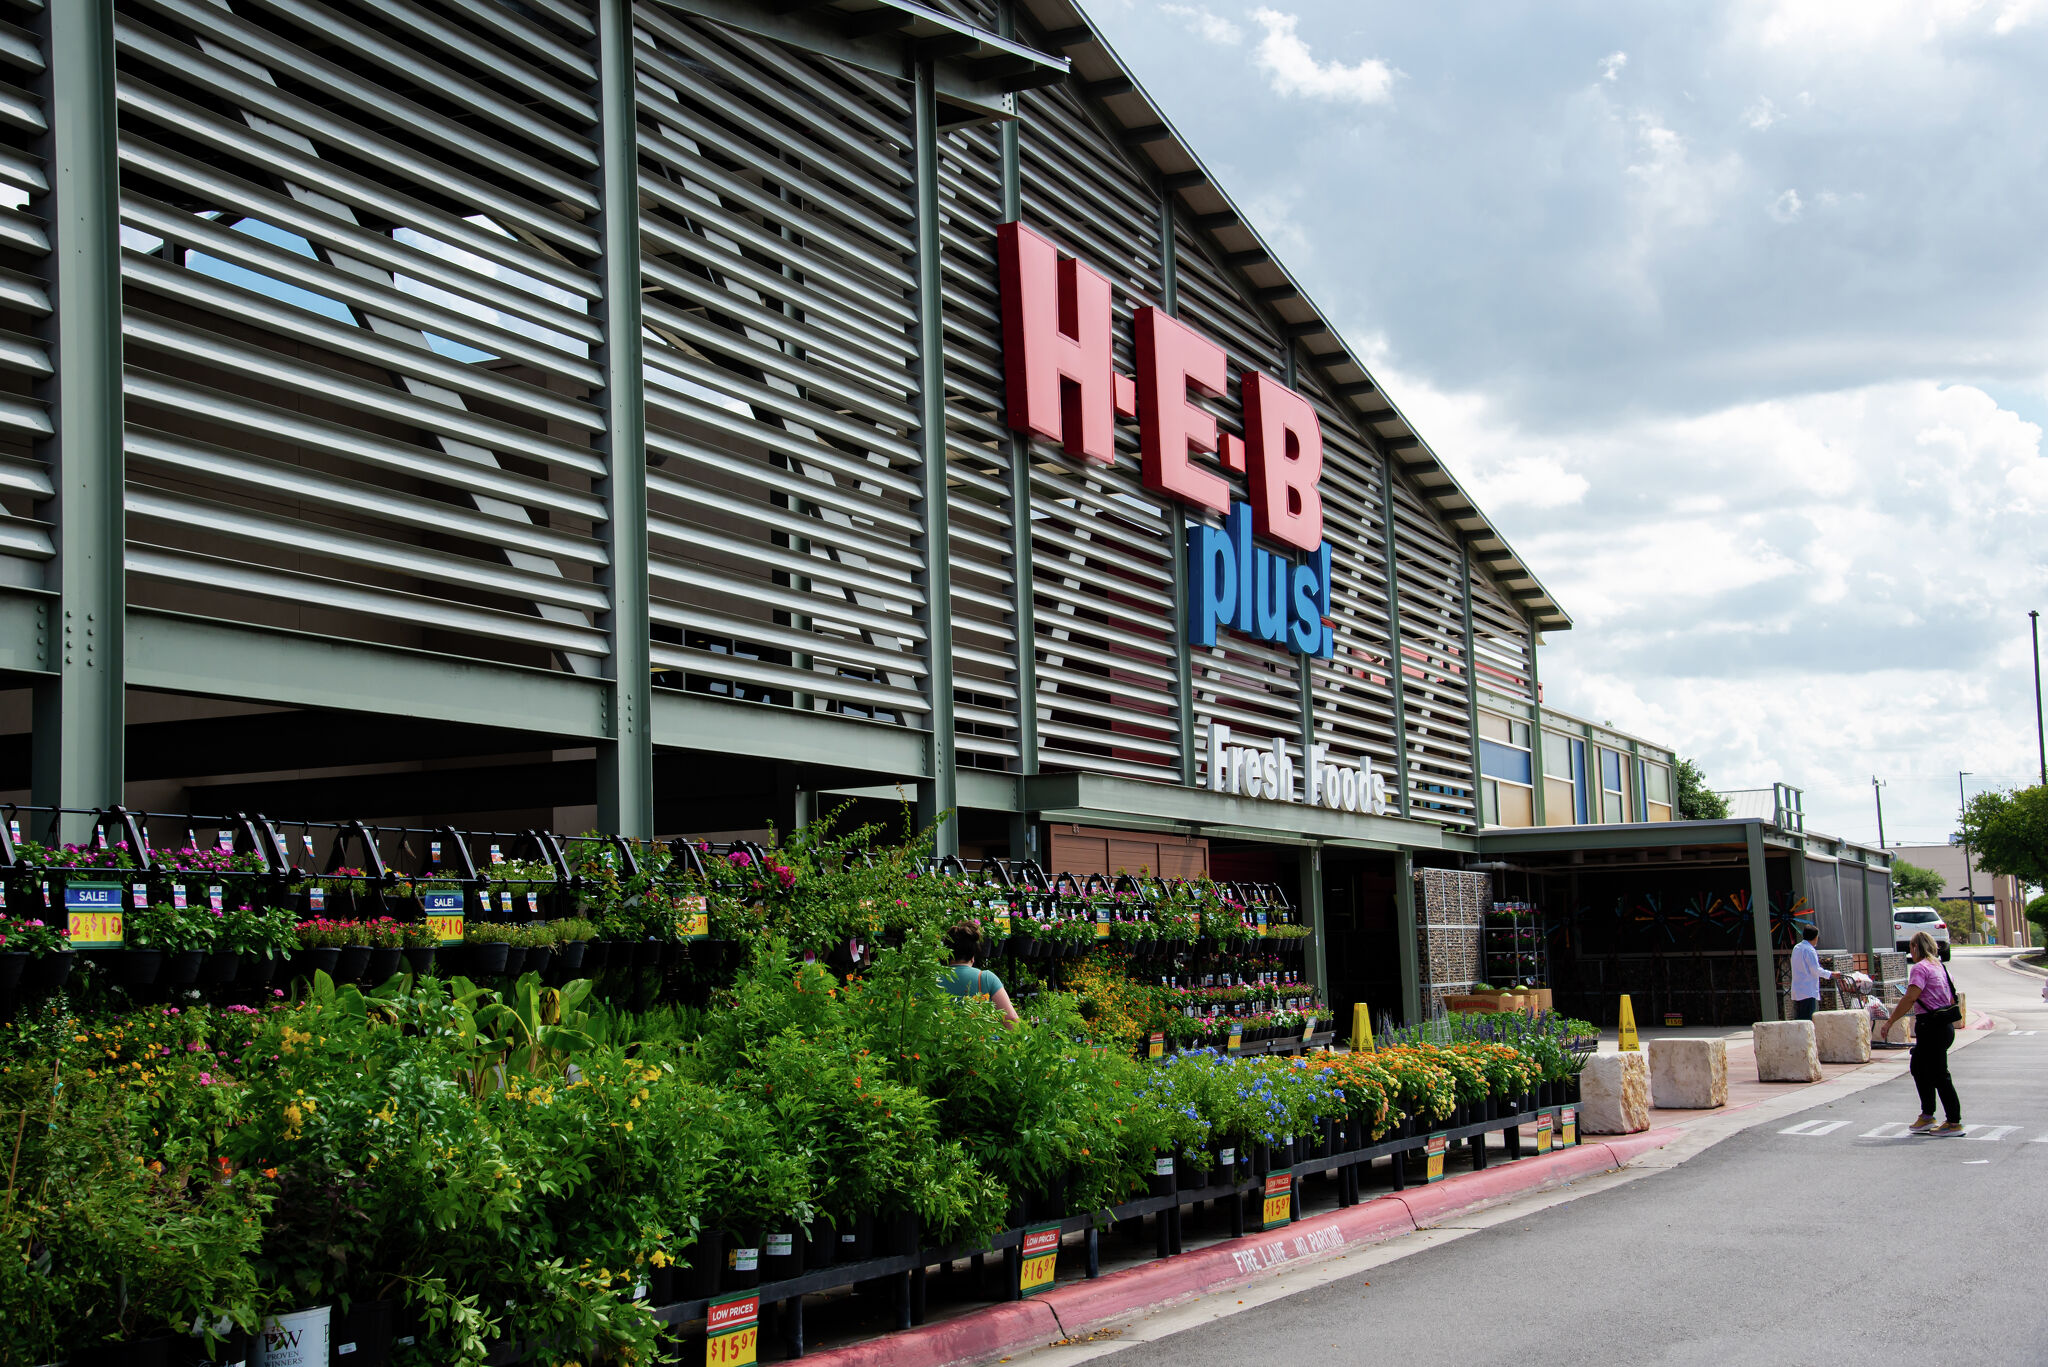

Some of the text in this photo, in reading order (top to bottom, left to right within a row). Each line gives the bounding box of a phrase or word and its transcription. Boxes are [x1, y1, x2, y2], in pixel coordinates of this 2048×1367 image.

[997, 221, 1323, 552] H-E-B
[1207, 723, 1387, 816] Fresh Foods
[79, 891, 108, 902] SALE!
[434, 897, 454, 907] SALE!
[71, 916, 81, 936] 2
[1026, 1233, 1056, 1247] LOW PRICES
[1231, 1224, 1345, 1274] FIRE LANE NO PARKING
[712, 1303, 754, 1322] LOW PRICES
[264, 1358, 304, 1367] WINNERS
[266, 1351, 300, 1361] PROVEN
